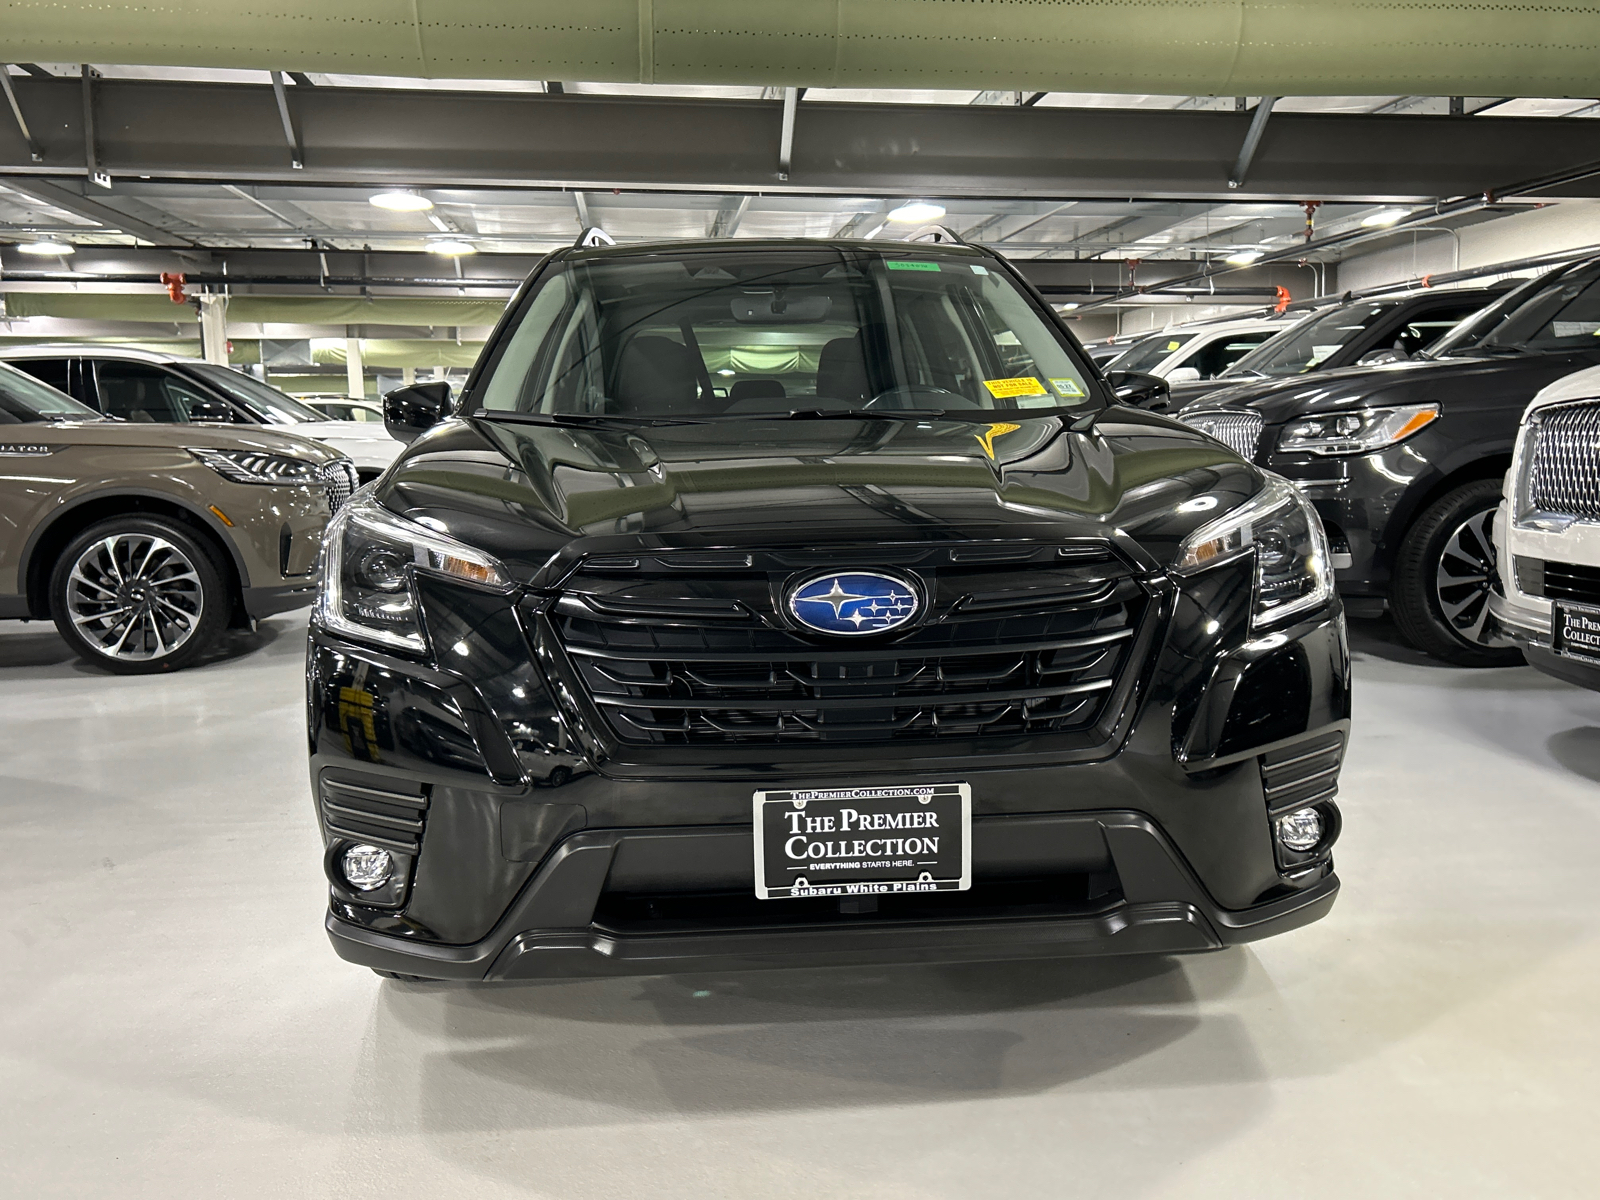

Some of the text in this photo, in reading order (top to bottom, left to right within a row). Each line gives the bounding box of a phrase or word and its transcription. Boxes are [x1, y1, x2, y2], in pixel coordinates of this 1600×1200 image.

[1564, 614, 1580, 628] THE
[784, 808, 939, 834] THE PREMIER
[784, 836, 939, 860] COLLECTION
[810, 862, 860, 870] EVERYTHING
[892, 860, 914, 868] HERE.
[790, 882, 937, 896] Subaru White Plains
